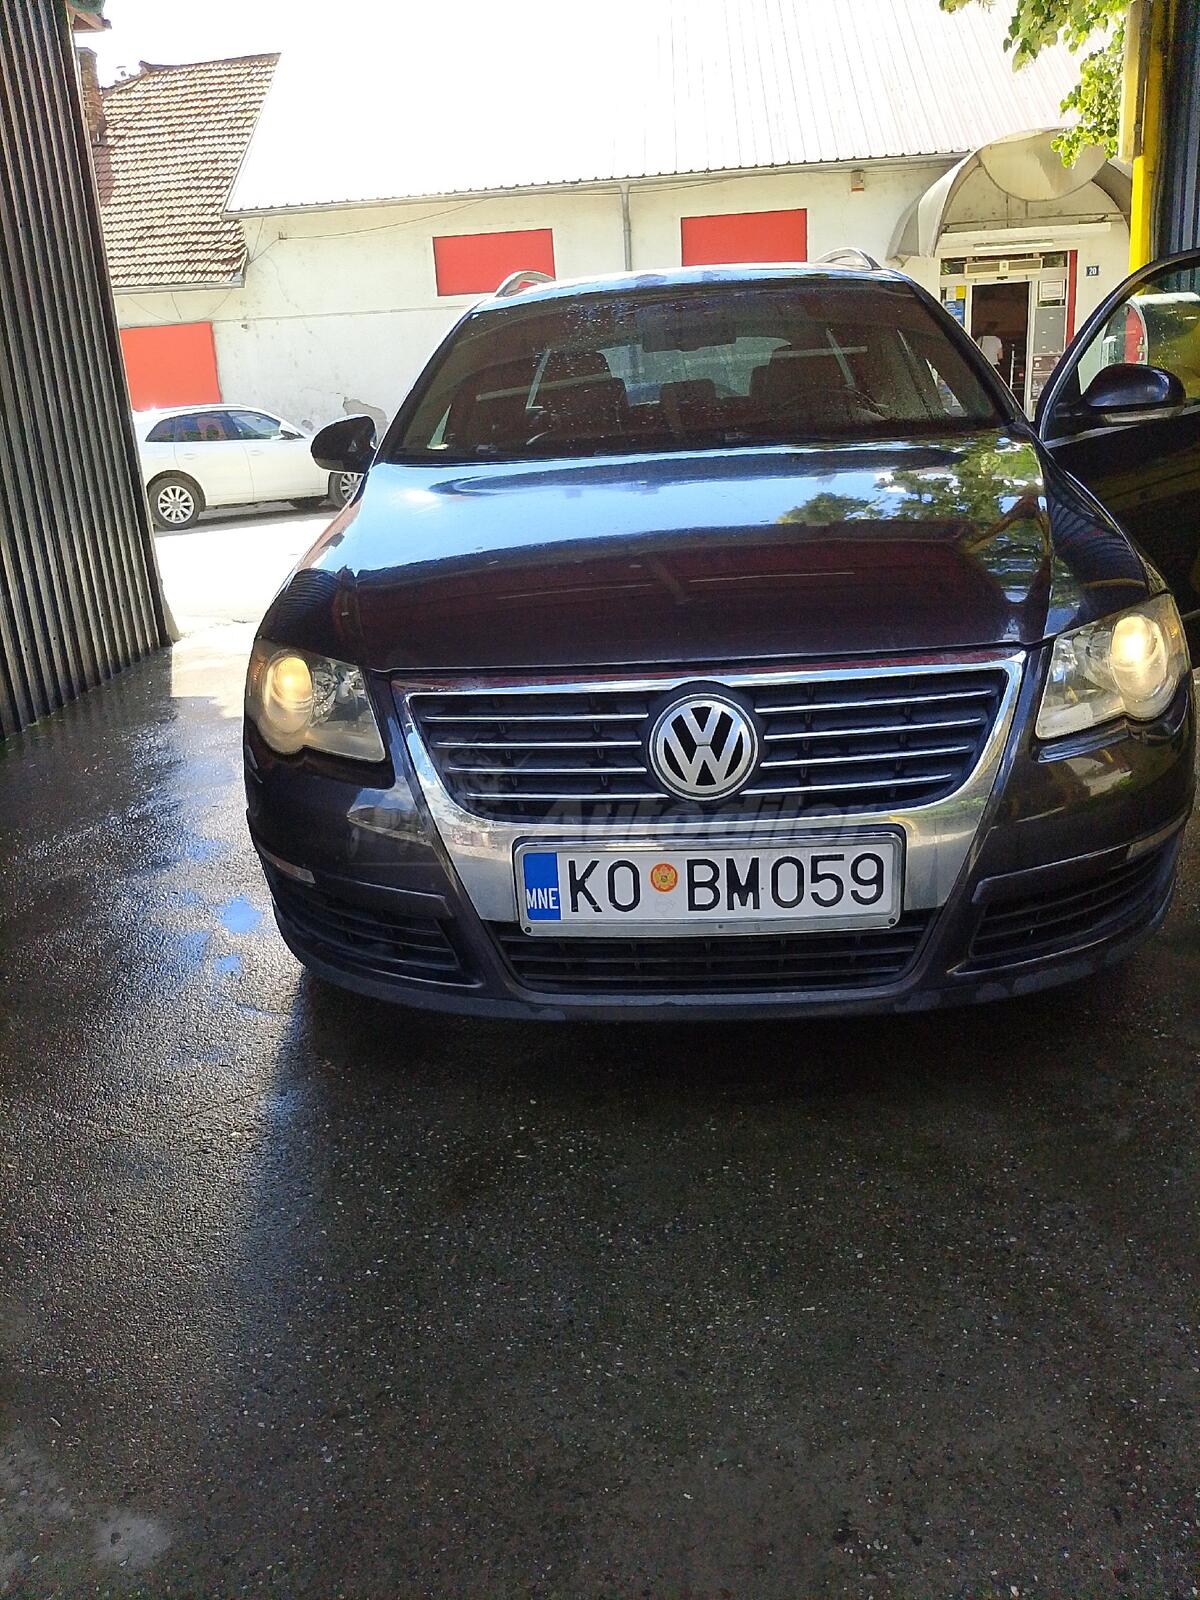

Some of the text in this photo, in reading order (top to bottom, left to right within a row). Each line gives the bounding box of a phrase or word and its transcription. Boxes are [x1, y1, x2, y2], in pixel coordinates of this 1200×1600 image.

[1088, 266, 1097, 276] 20
[567, 859, 641, 913] KO
[526, 887, 559, 910] MNE
